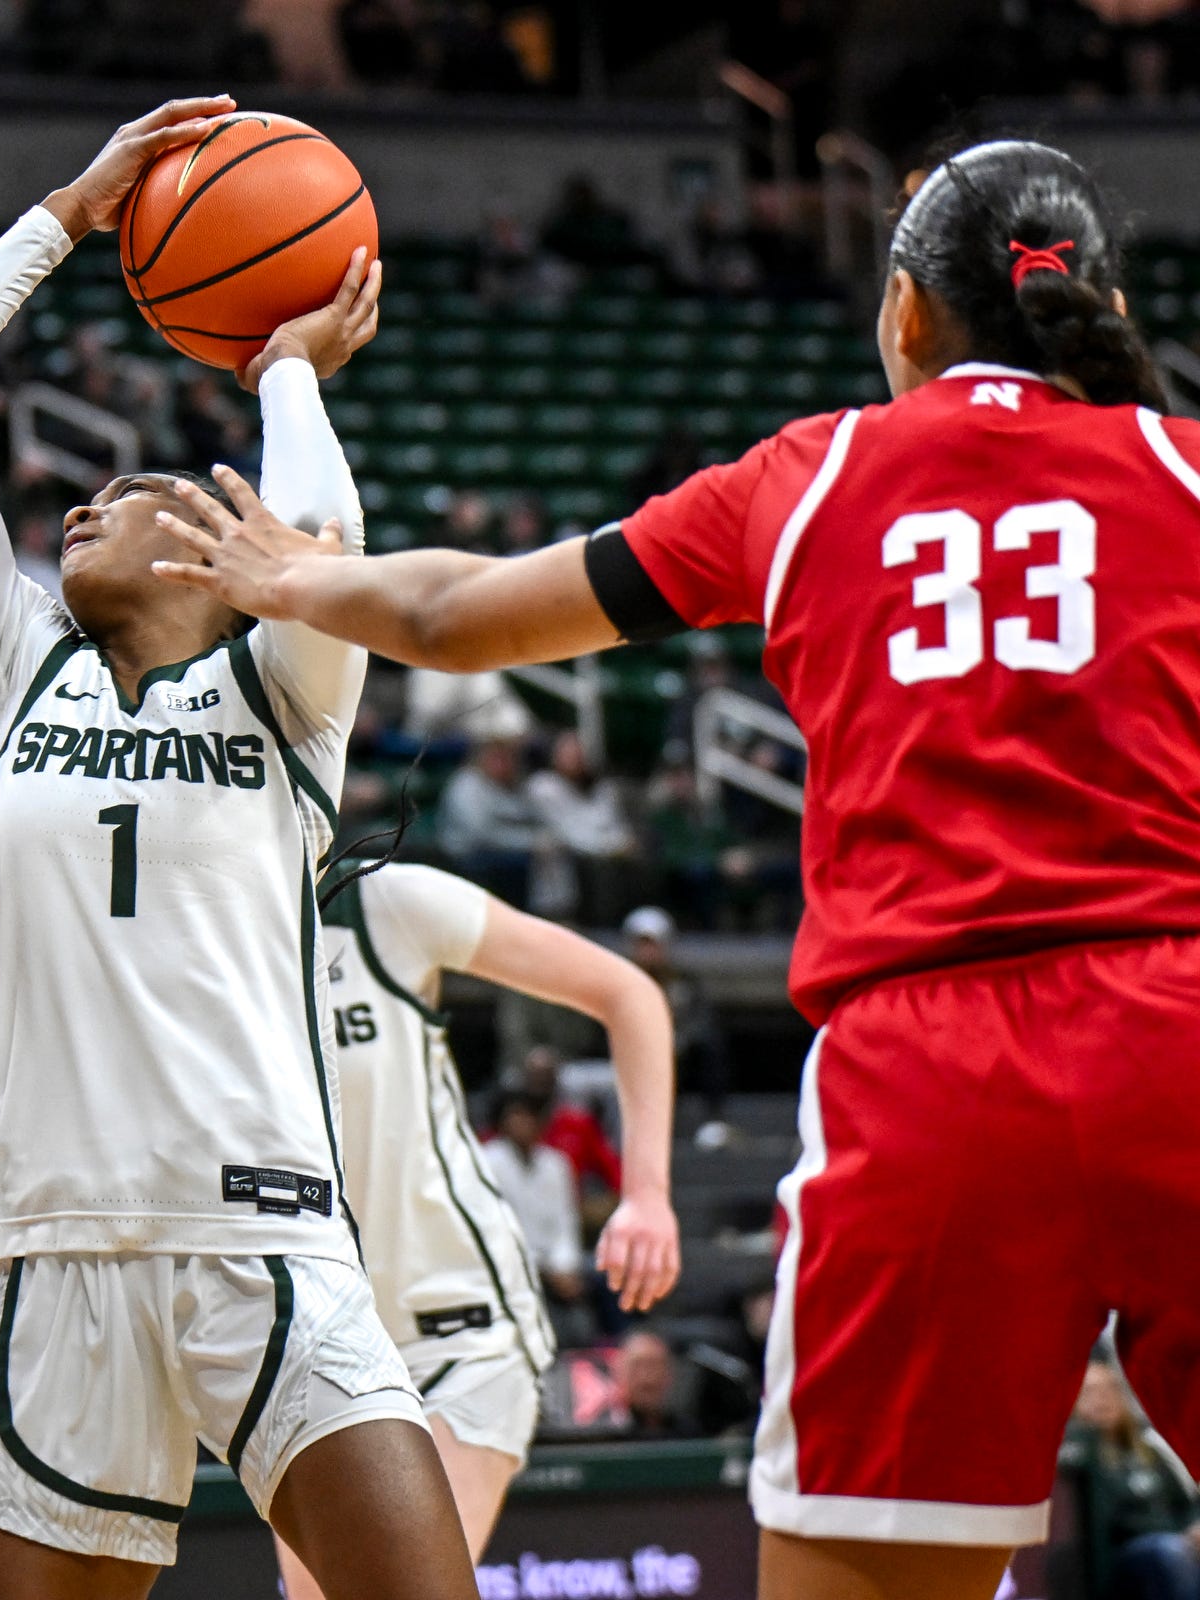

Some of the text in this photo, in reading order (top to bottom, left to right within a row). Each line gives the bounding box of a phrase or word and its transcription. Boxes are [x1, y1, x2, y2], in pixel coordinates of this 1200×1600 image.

[969, 381, 1023, 413] N
[881, 499, 1097, 687] 33
[12, 721, 267, 791] SPARTANS
[98, 803, 140, 918] 1
[302, 1184, 320, 1201] 42
